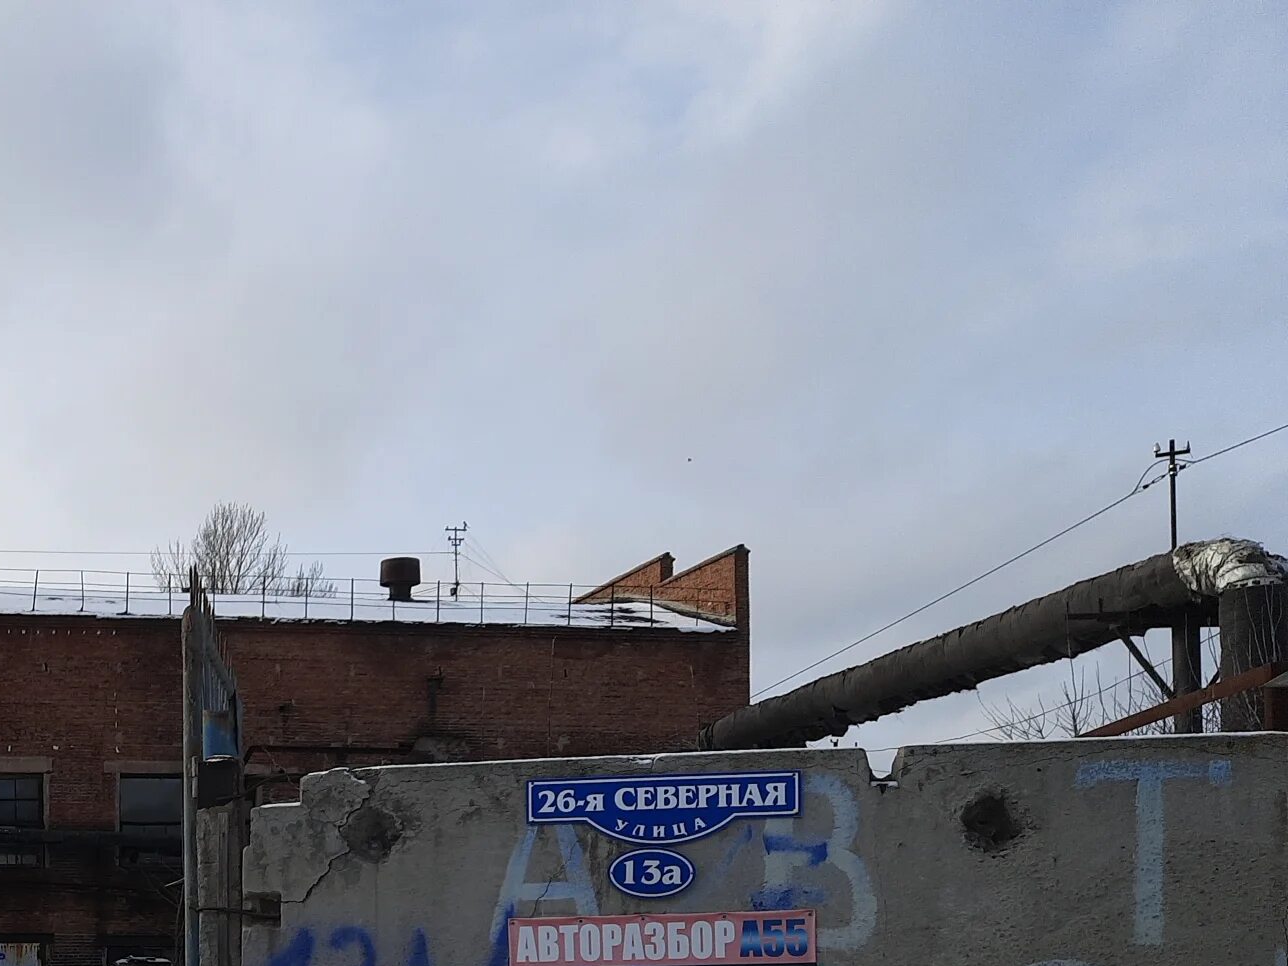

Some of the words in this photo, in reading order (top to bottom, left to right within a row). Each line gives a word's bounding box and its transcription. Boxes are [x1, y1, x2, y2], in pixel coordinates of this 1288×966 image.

[537, 788, 605, 813] 26-я
[614, 782, 787, 811] СЕВЕРНАЯ
[615, 817, 707, 838] УЛИЦА
[623, 860, 682, 885] 13а
[516, 920, 735, 963] АВТОРАЗБОР
[740, 918, 808, 957] А55
